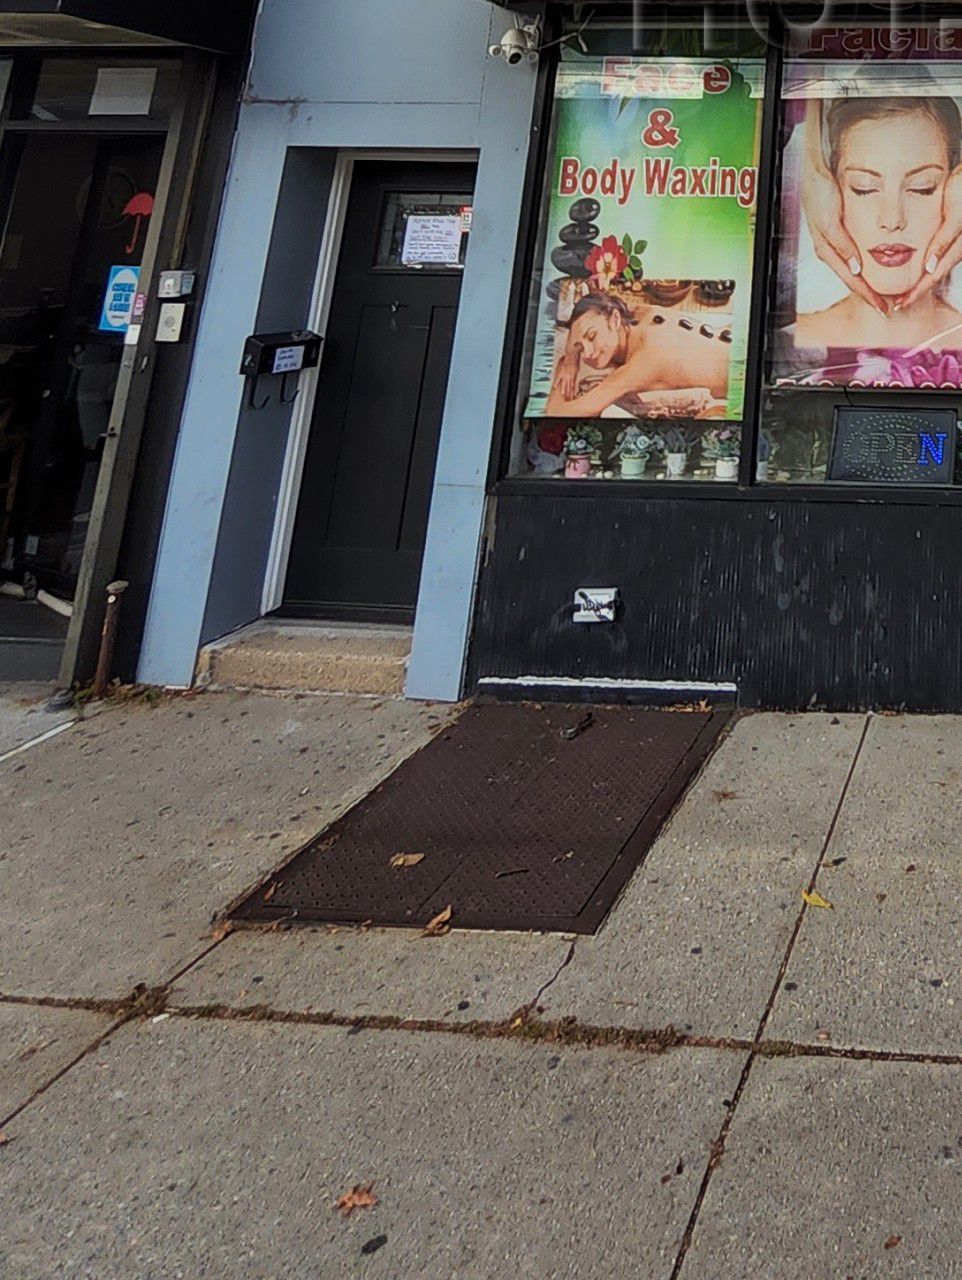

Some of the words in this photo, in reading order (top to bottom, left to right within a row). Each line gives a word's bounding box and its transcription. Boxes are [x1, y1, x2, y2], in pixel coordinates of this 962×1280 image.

[601, 56, 732, 95] Face
[641, 107, 682, 149] &
[557, 156, 636, 207] Body
[643, 156, 759, 208] Waxing
[843, 432, 948, 466] OPEN
